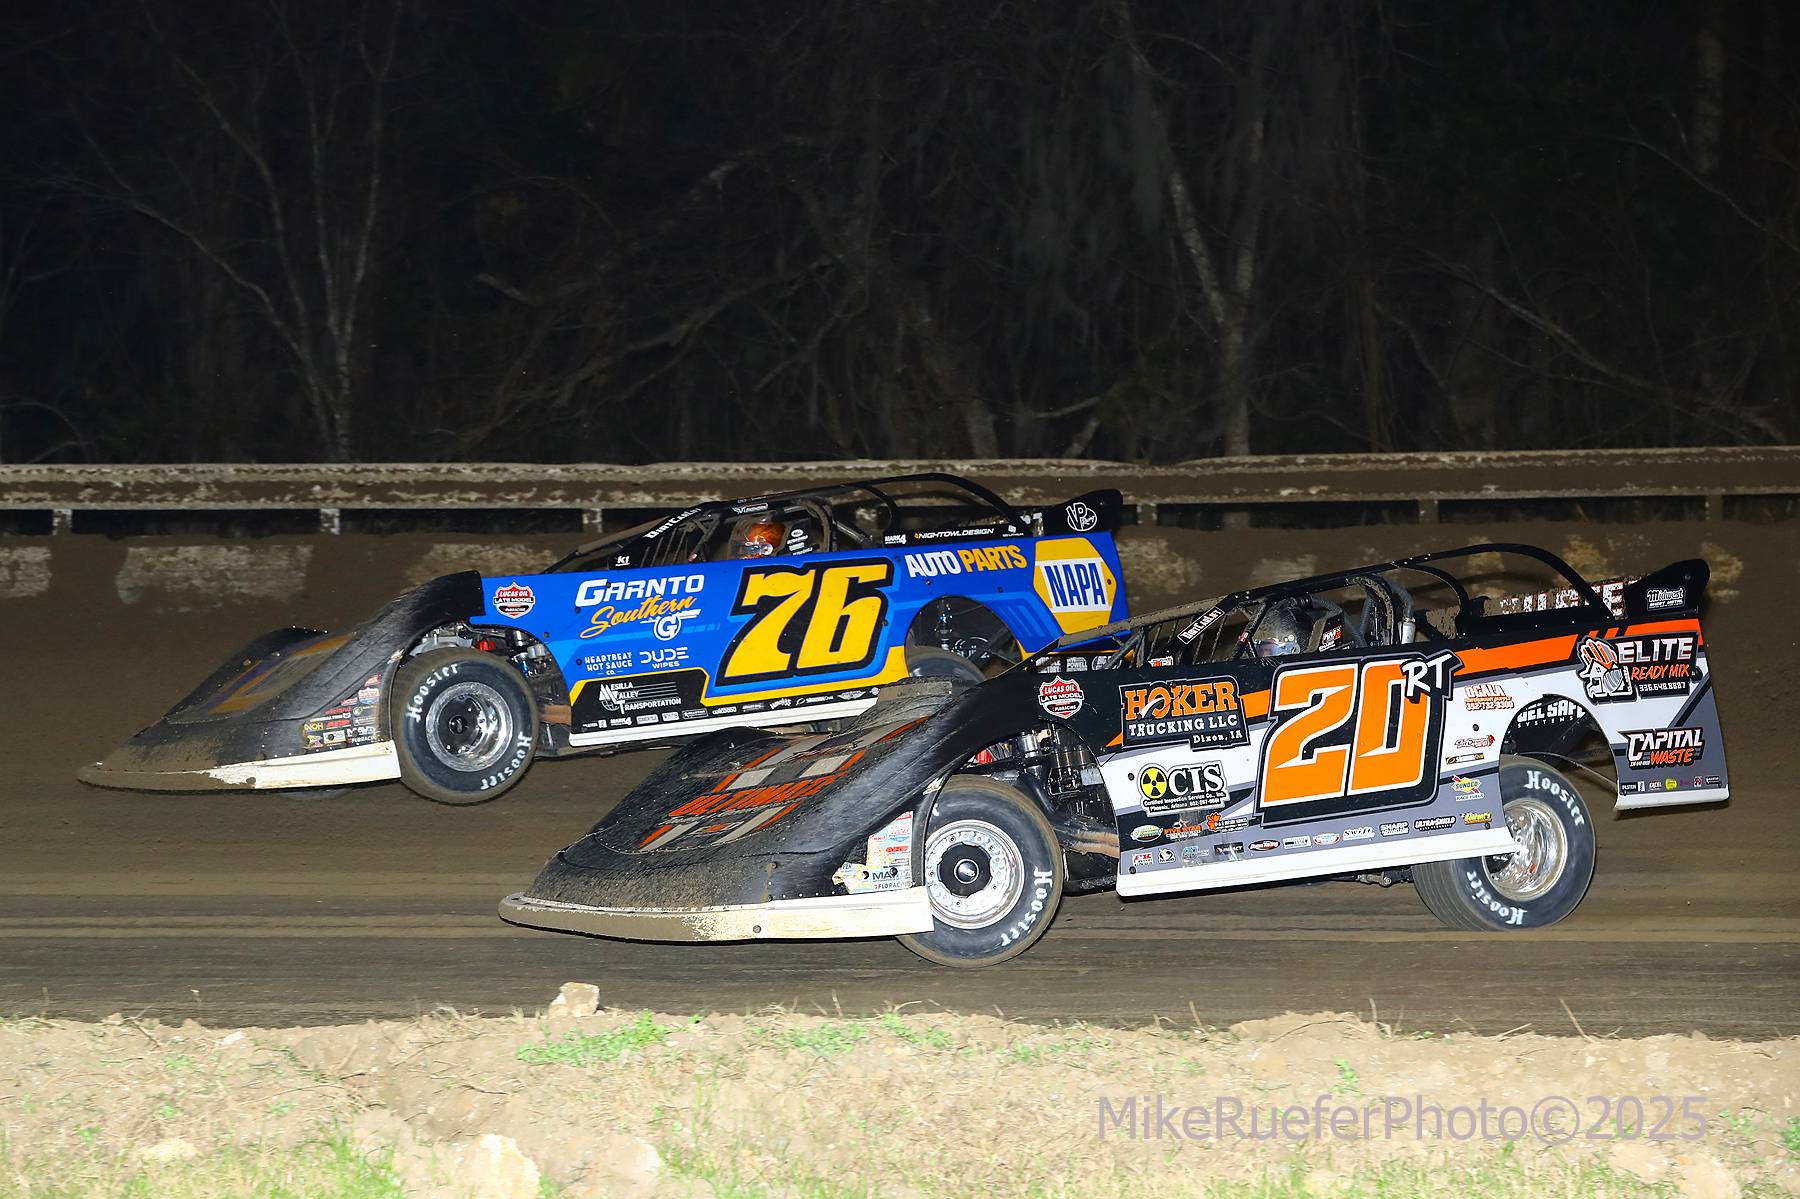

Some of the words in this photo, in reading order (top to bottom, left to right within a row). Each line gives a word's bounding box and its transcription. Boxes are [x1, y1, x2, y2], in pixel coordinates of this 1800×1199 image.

[904, 550, 962, 578] AUTO
[957, 545, 1028, 573] PARTS
[575, 574, 705, 607] GARNTO
[1044, 561, 1106, 609] NAPA
[1647, 587, 1684, 600] Midwest
[580, 595, 697, 638] Southern
[720, 561, 891, 682] 76
[584, 652, 633, 664] HEARTBEAT
[639, 646, 689, 664] DUDE
[1615, 637, 1694, 663] ELITE
[586, 662, 605, 672] HOT
[606, 659, 633, 671] SAUCE
[652, 660, 680, 669] WIPES
[1401, 654, 1453, 698] RT
[1631, 665, 1668, 682] READY
[1669, 664, 1690, 678] MIX
[406, 662, 459, 723] Hoosier
[1040, 694, 1058, 703] LATE
[1058, 691, 1083, 699] MODEL
[1044, 685, 1065, 695] LUCAS
[1065, 684, 1076, 692] OIL
[1125, 681, 1239, 721] HOKER
[1465, 684, 1507, 698] OCALA
[616, 698, 682, 714] TRANSPORTATION
[1129, 718, 1205, 737] TRUCKING
[1209, 714, 1238, 729] LLC
[1260, 659, 1431, 808] 20
[1517, 715, 1575, 729] SYSTEMS
[1229, 730, 1243, 741] IA
[1627, 728, 1704, 761] CAPITAL
[480, 731, 532, 791] Hoosier
[1650, 747, 1695, 766] WASTE
[1168, 763, 1225, 797] CIS
[1454, 781, 1480, 791] SUNOCO
[1188, 794, 1205, 802] Service
[1523, 770, 1585, 827] Hoosier
[1380, 822, 1409, 832] SHARP
[1000, 866, 1053, 947] Hoosier
[1466, 871, 1528, 925] Hoosier
